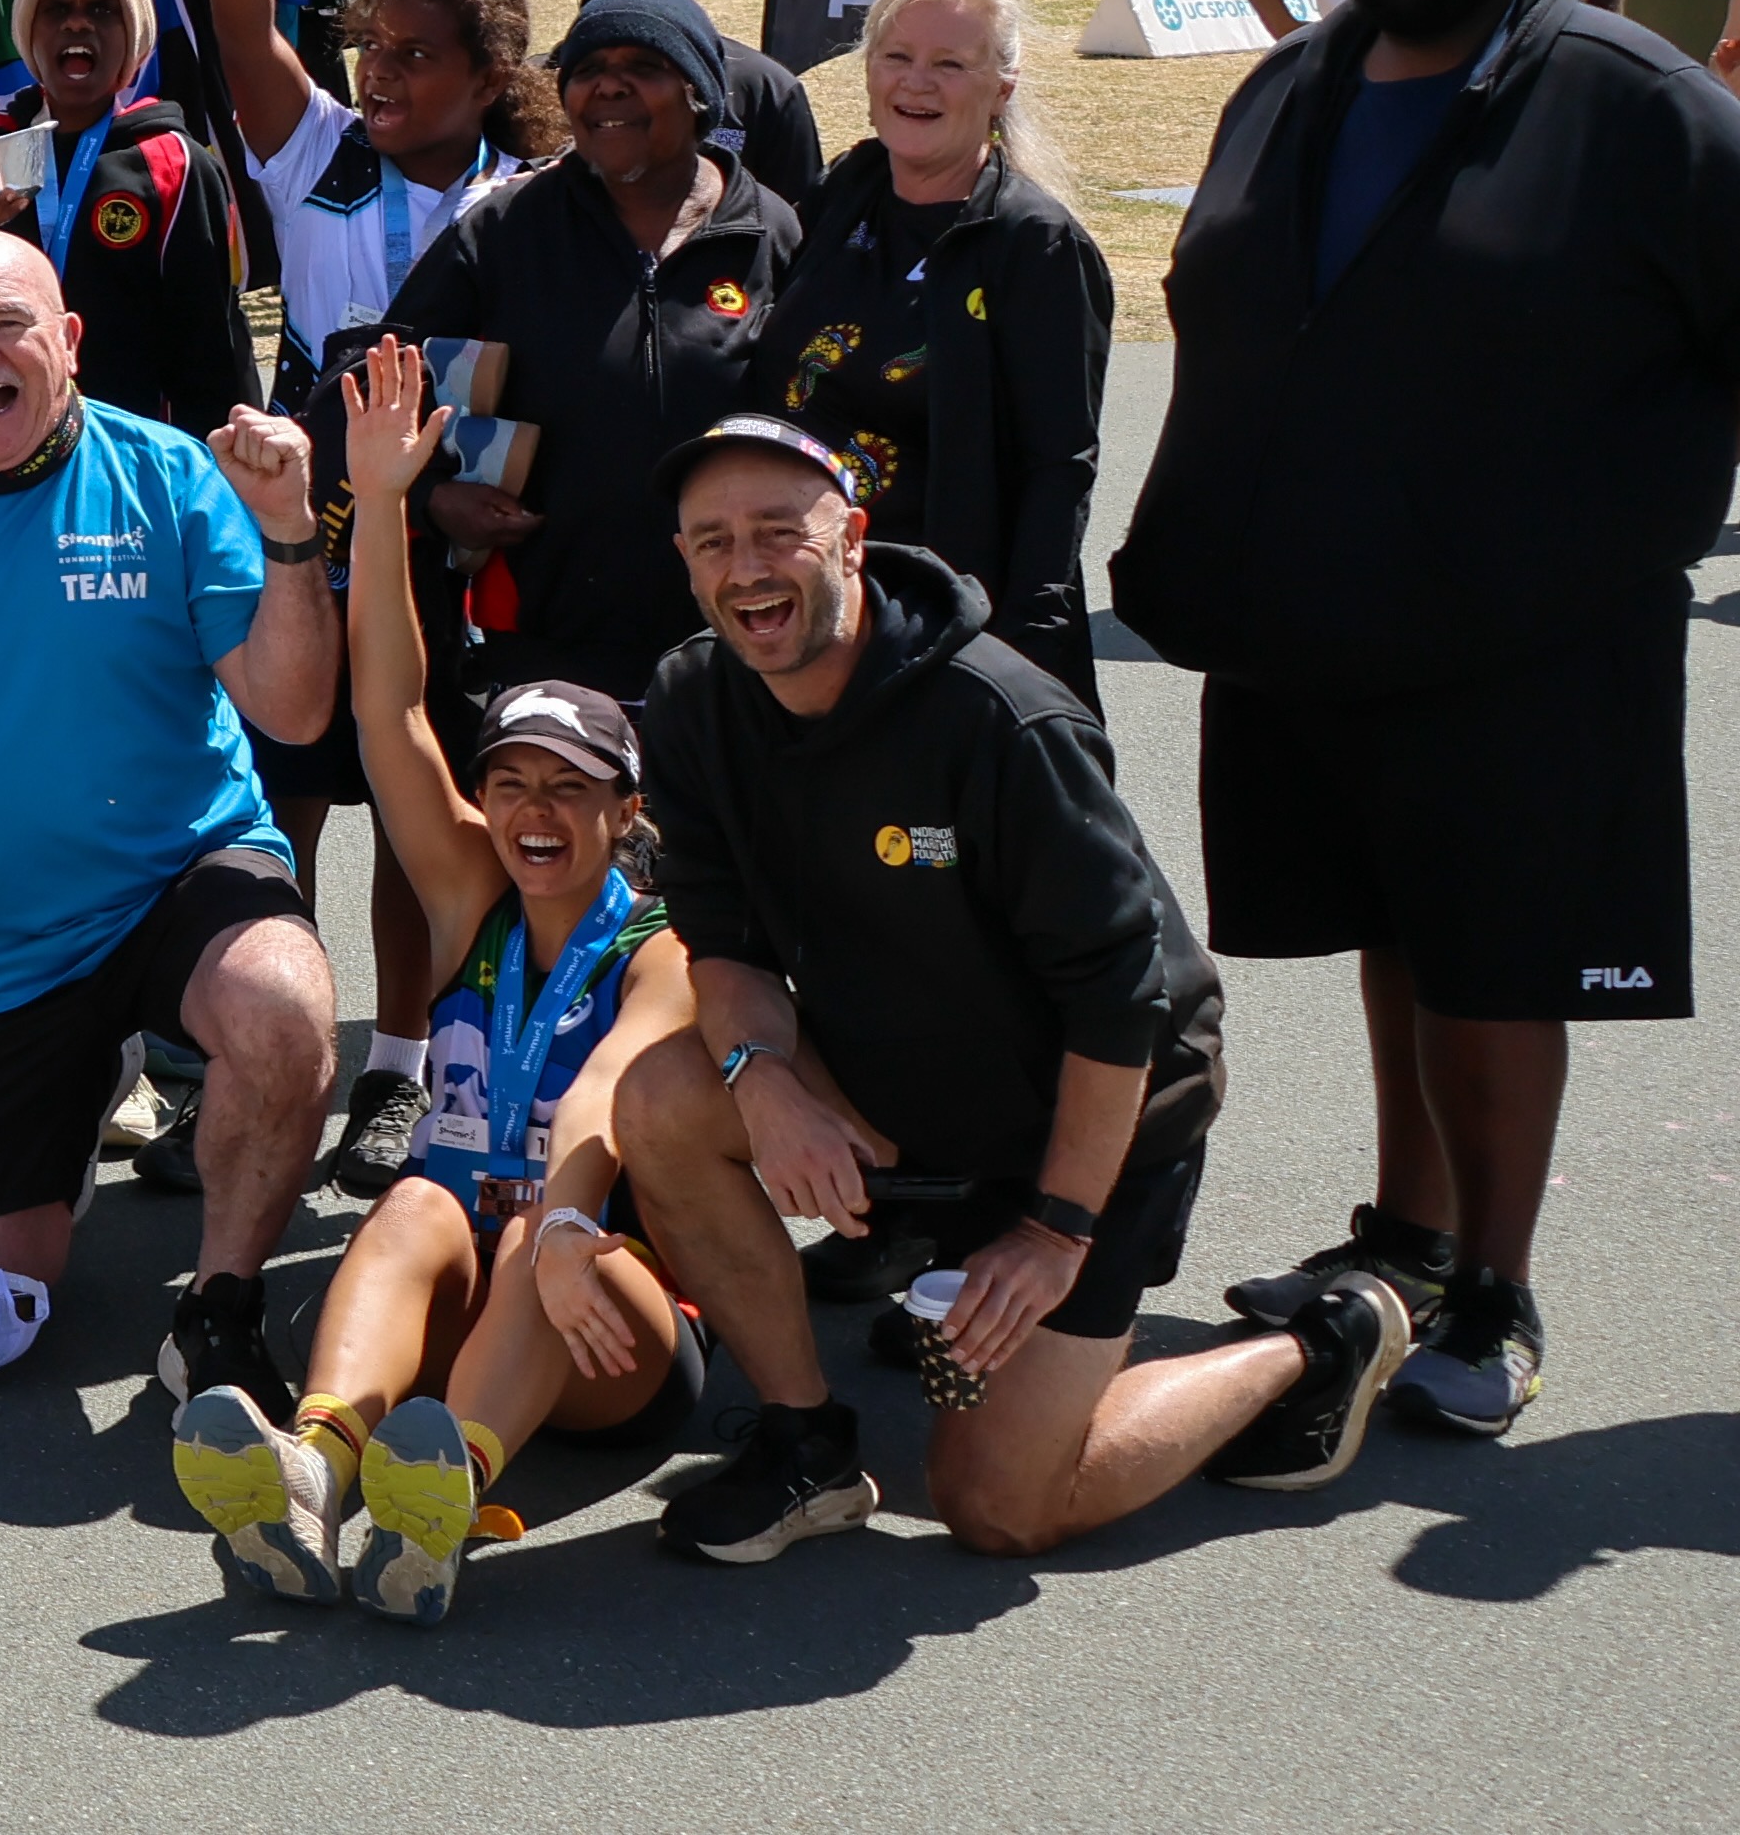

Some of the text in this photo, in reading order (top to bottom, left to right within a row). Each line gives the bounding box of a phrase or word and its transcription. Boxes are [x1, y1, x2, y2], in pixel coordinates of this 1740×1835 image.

[60, 572, 148, 602] TEAM
[913, 847, 959, 861] FOUNDATI
[1581, 965, 1655, 991] FILA
